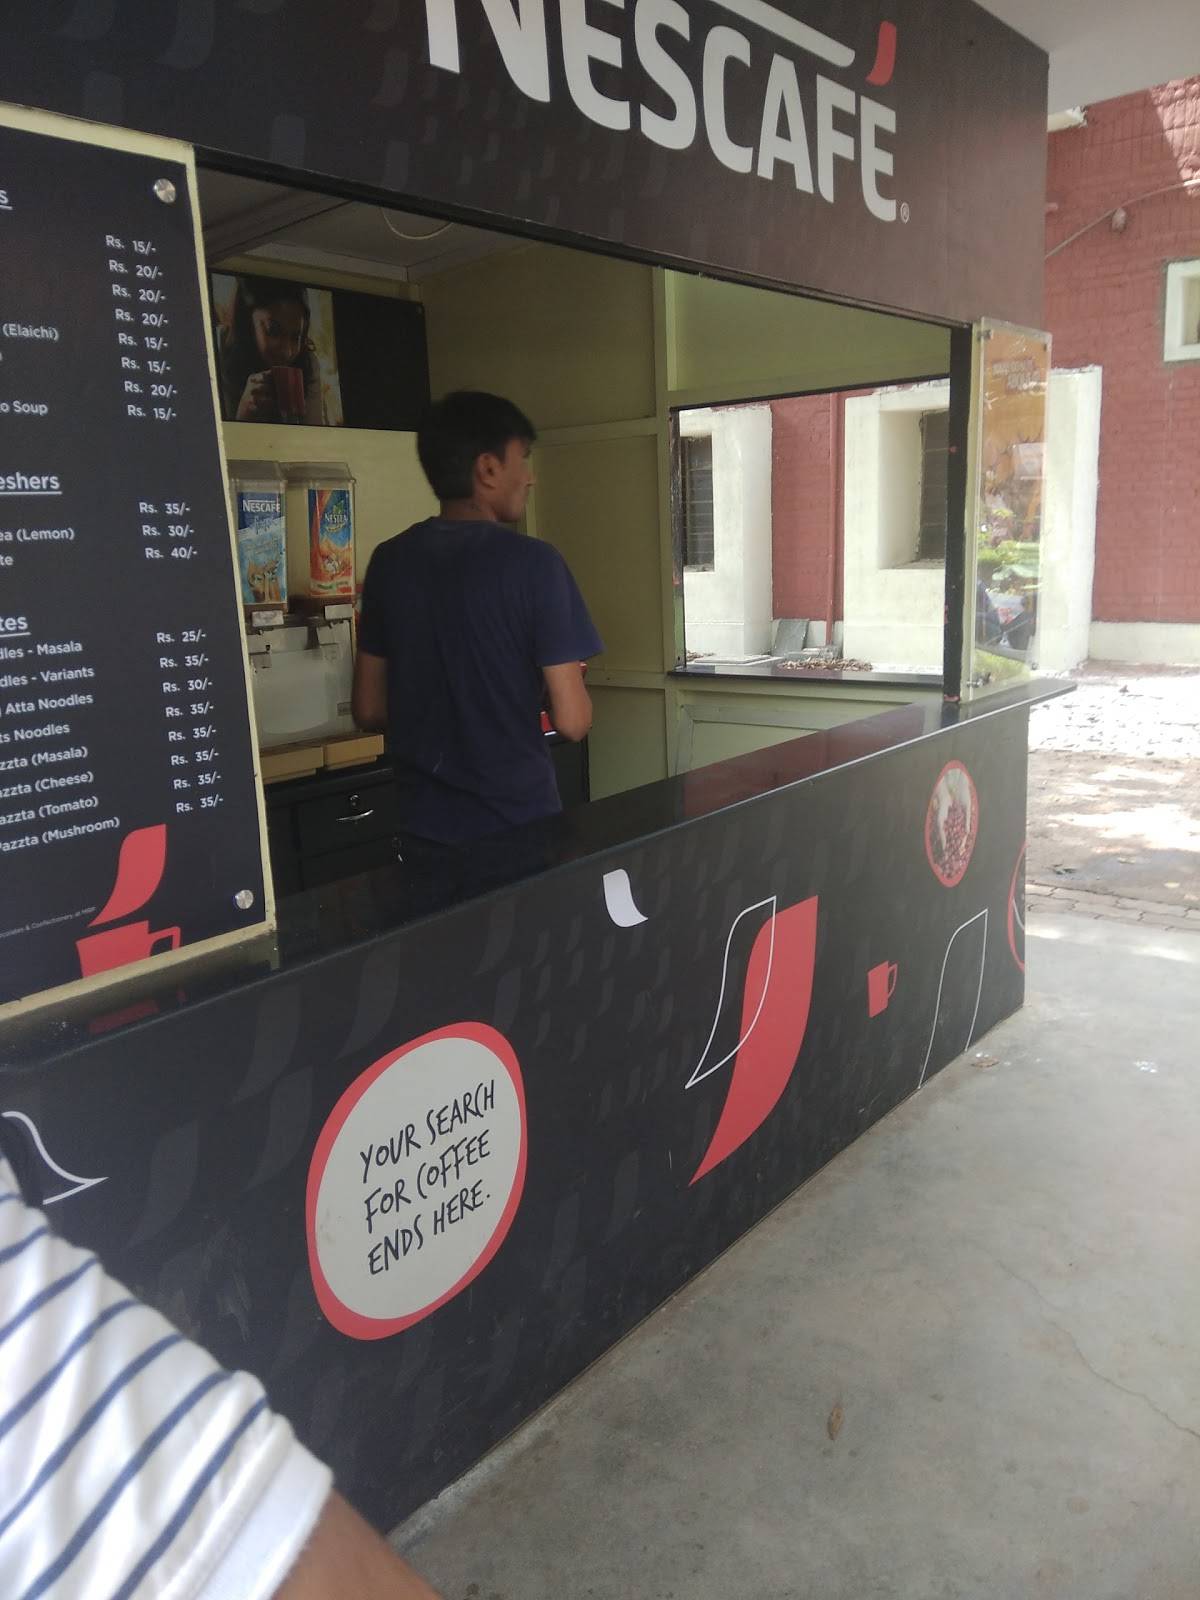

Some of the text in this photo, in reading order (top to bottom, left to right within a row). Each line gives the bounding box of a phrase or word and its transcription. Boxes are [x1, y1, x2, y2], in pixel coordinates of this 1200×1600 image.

[105, 234, 157, 255] Rs. 15/-
[108, 259, 163, 280] Rs. 20/-
[111, 283, 166, 304] Rs. 20/-
[114, 308, 169, 328] Rs. 20/-
[2, 323, 60, 341] (Elaichi)
[117, 332, 168, 351] Rs. 15/-
[120, 356, 171, 375] Rs. 15/-
[123, 380, 178, 398] Rs. 20/-
[12, 399, 49, 417] Soup
[127, 404, 177, 421] Rs. 15/-
[138, 501, 191, 516] Rs. 35/-
[15, 527, 76, 543] (Lemon)
[141, 524, 195, 538] Rs. 30/-
[144, 545, 198, 560] Rs. 40/-
[156, 628, 207, 644] Rs. 25/-
[36, 640, 83, 656] Masala
[159, 653, 209, 669] Rs. 35/-
[0, 674, 29, 688] dles
[39, 666, 95, 683] Variants
[162, 677, 213, 693] Rs. 30/-
[4, 701, 36, 715] Atta
[37, 693, 94, 711] Noodles
[165, 701, 214, 718] Rs. 35/-
[13, 723, 71, 741] Noodles
[167, 724, 217, 742] Rs. 35/-
[31, 746, 89, 764] (Masala)
[170, 747, 220, 766] Rs. 35/-
[0, 771, 94, 799] zzta (Cheese)
[173, 770, 222, 790] Rs. 35/-
[38, 796, 99, 817] (Tomato)
[175, 793, 224, 813] Rs. 35/-
[0, 816, 121, 852] azzta (Mushroom)
[359, 1079, 496, 1187] YOUR SEARCH
[364, 1128, 491, 1235] FOR COFFEE
[367, 1178, 491, 1276] ENDS HERE.
